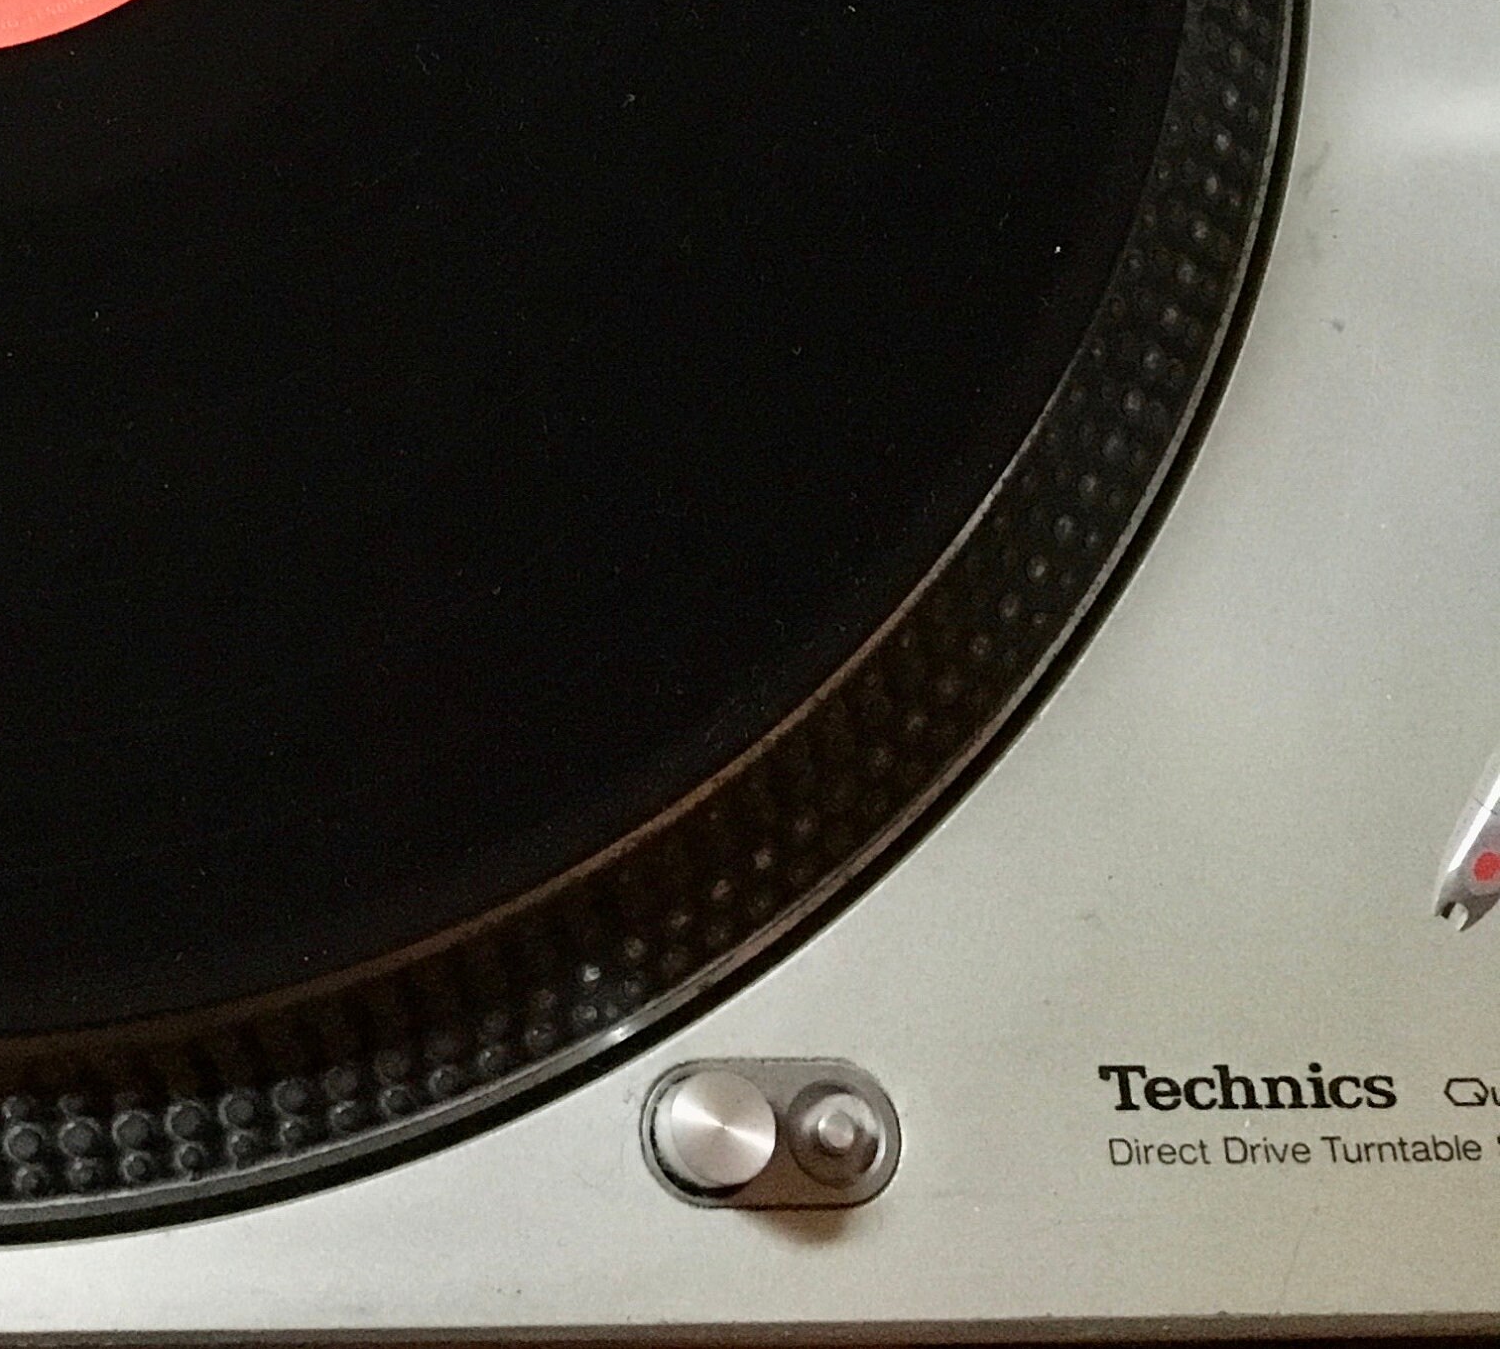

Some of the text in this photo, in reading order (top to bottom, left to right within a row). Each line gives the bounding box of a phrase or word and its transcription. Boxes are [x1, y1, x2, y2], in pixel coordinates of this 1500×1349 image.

[1097, 1062, 1397, 1111] Technics
[1108, 1134, 1483, 1166] Direct Drive Turntable
